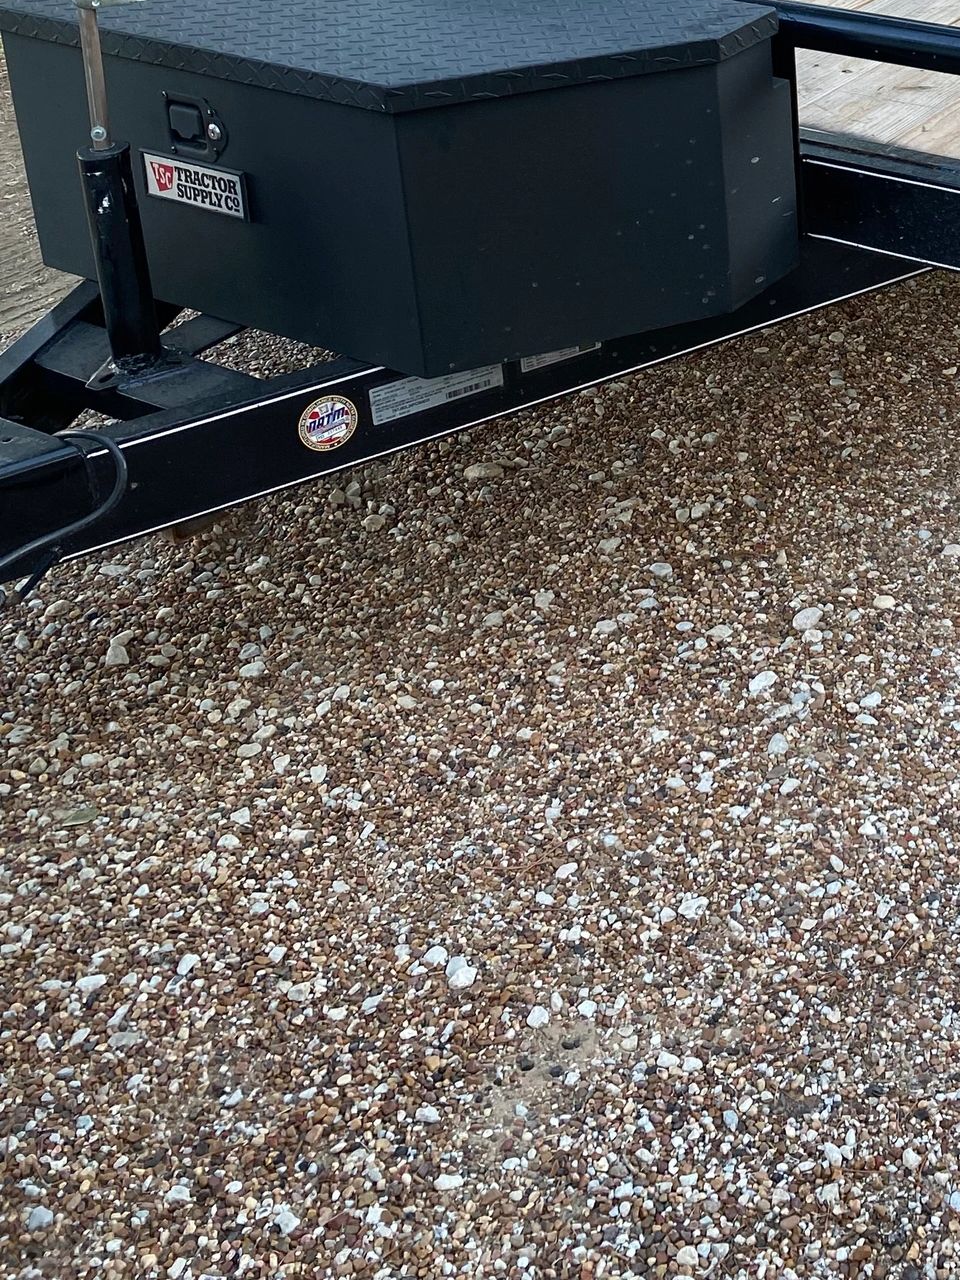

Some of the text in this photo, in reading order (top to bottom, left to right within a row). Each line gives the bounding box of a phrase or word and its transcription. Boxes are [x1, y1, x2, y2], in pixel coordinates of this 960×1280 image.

[152, 161, 172, 189] TSC
[174, 165, 238, 196] TRACTOR
[176, 182, 223, 209] SUPPLY
